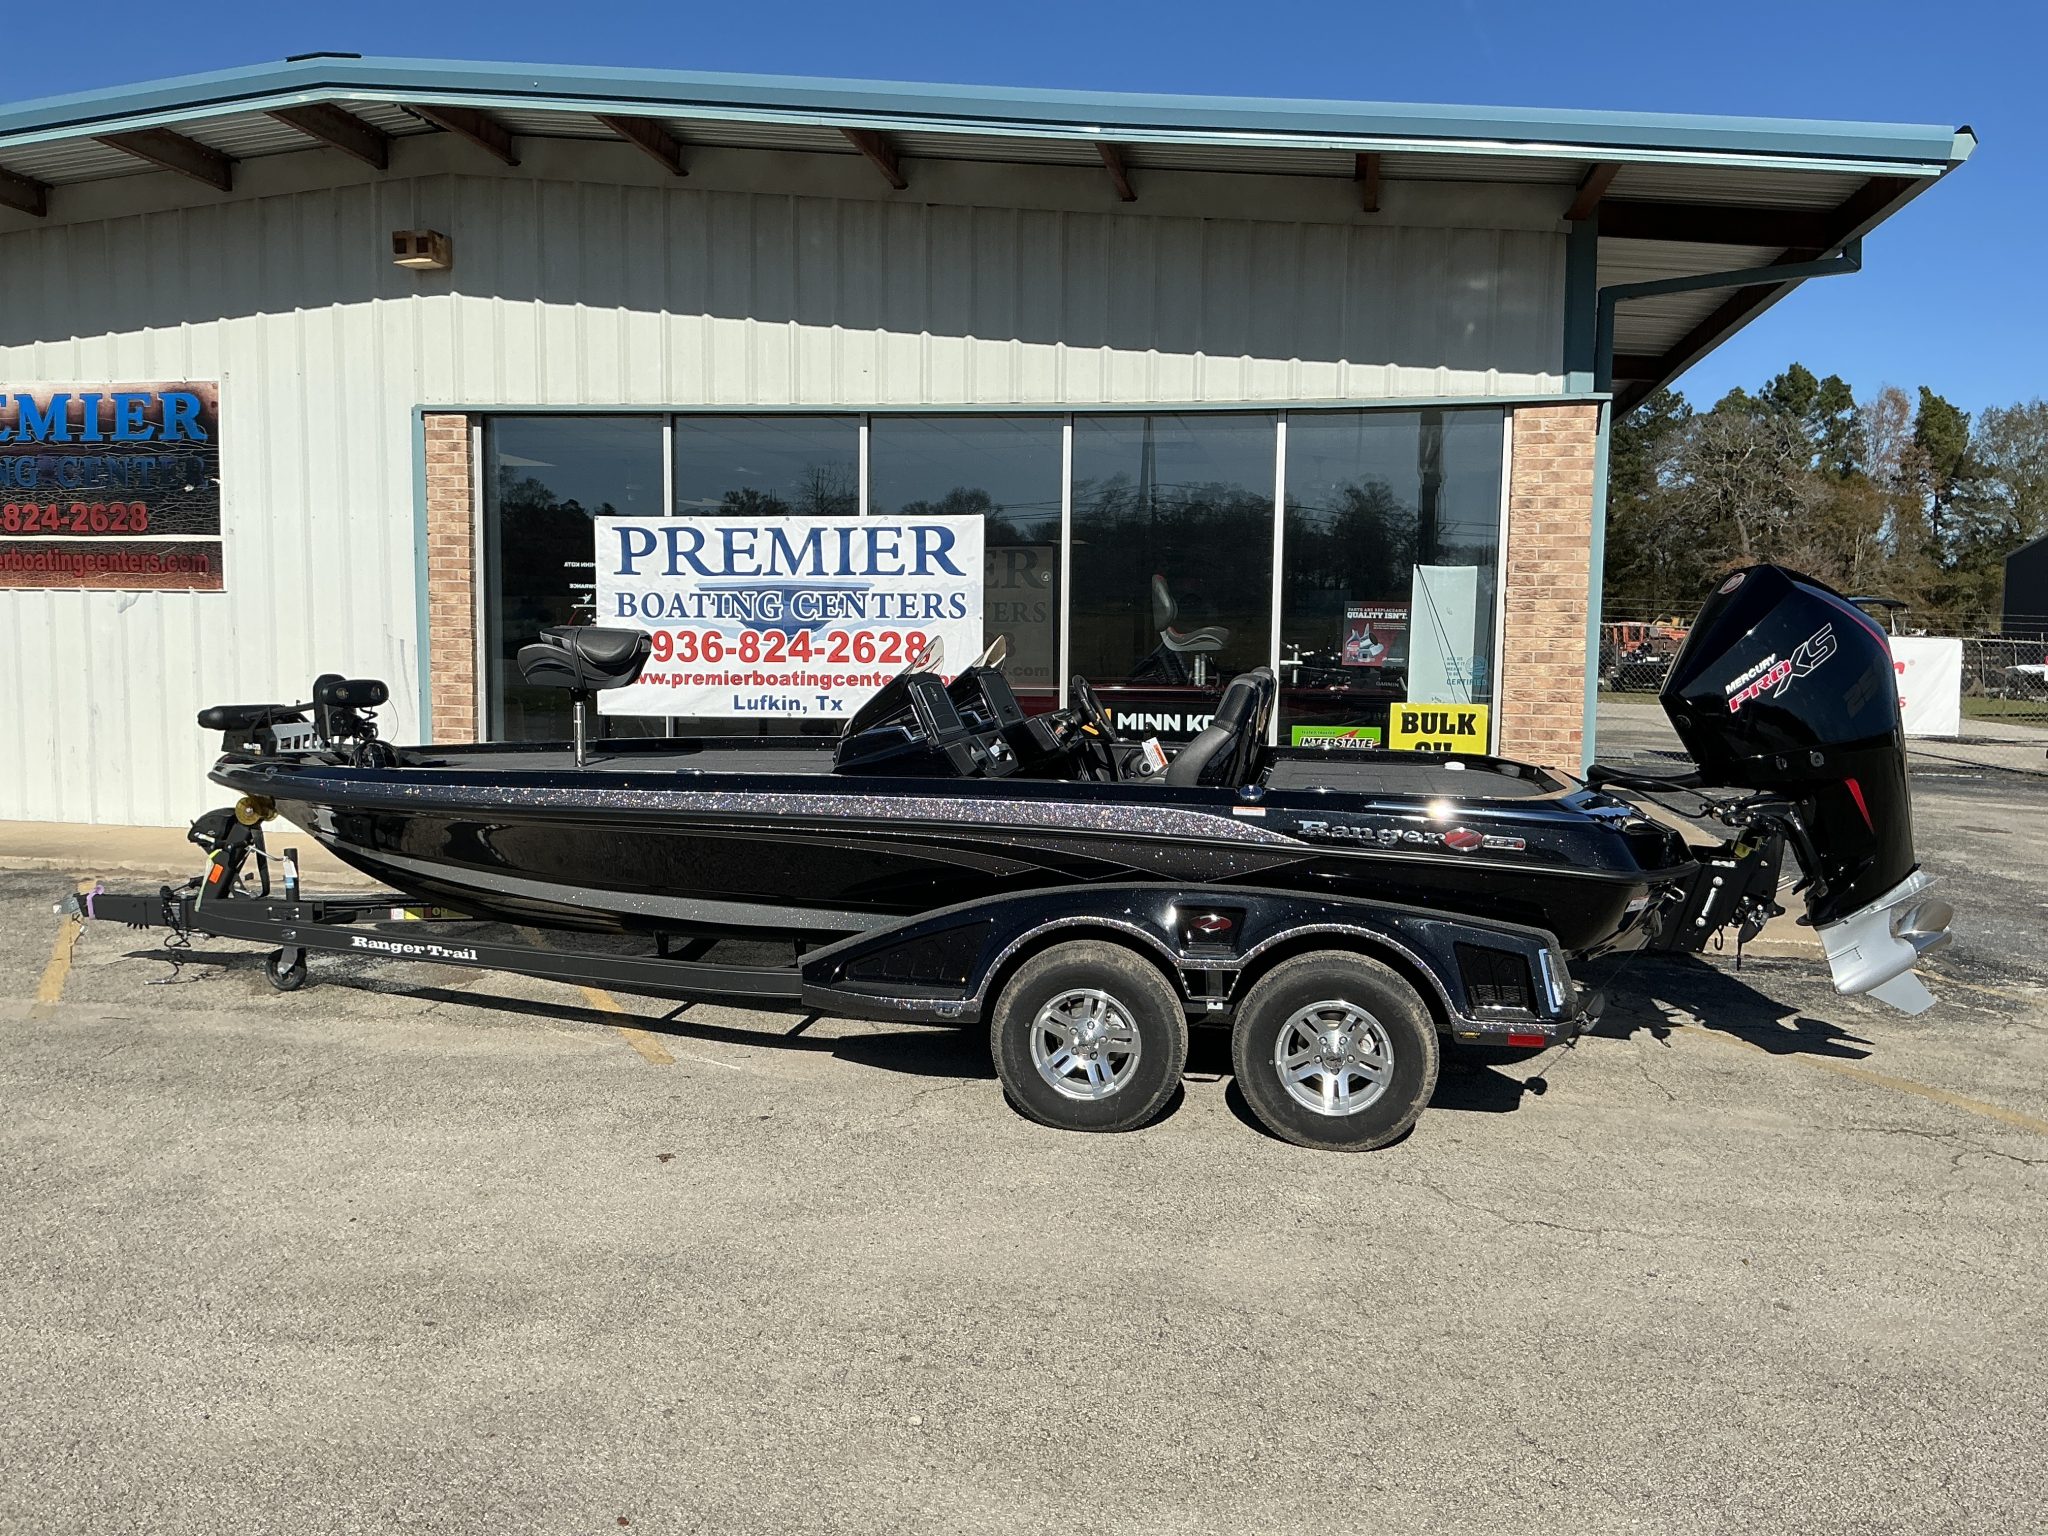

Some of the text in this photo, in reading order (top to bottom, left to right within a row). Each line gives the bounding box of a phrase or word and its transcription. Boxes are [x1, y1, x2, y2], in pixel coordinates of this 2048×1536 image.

[612, 526, 967, 577] PREMIER
[614, 591, 967, 621] BOATING CENTERS
[1347, 611, 1383, 619] QUALITY
[652, 630, 927, 663] 936-824-2628
[1725, 653, 1776, 695] MERCURY
[1728, 659, 1792, 713] PRO
[734, 695, 842, 714] Lufkin, Tx
[1117, 712, 1181, 731] MINN
[1401, 711, 1477, 735] BULK
[1300, 737, 1373, 749] INTERSTATE
[1297, 820, 1446, 848] Ranger
[351, 935, 478, 961] Ranger Trail
